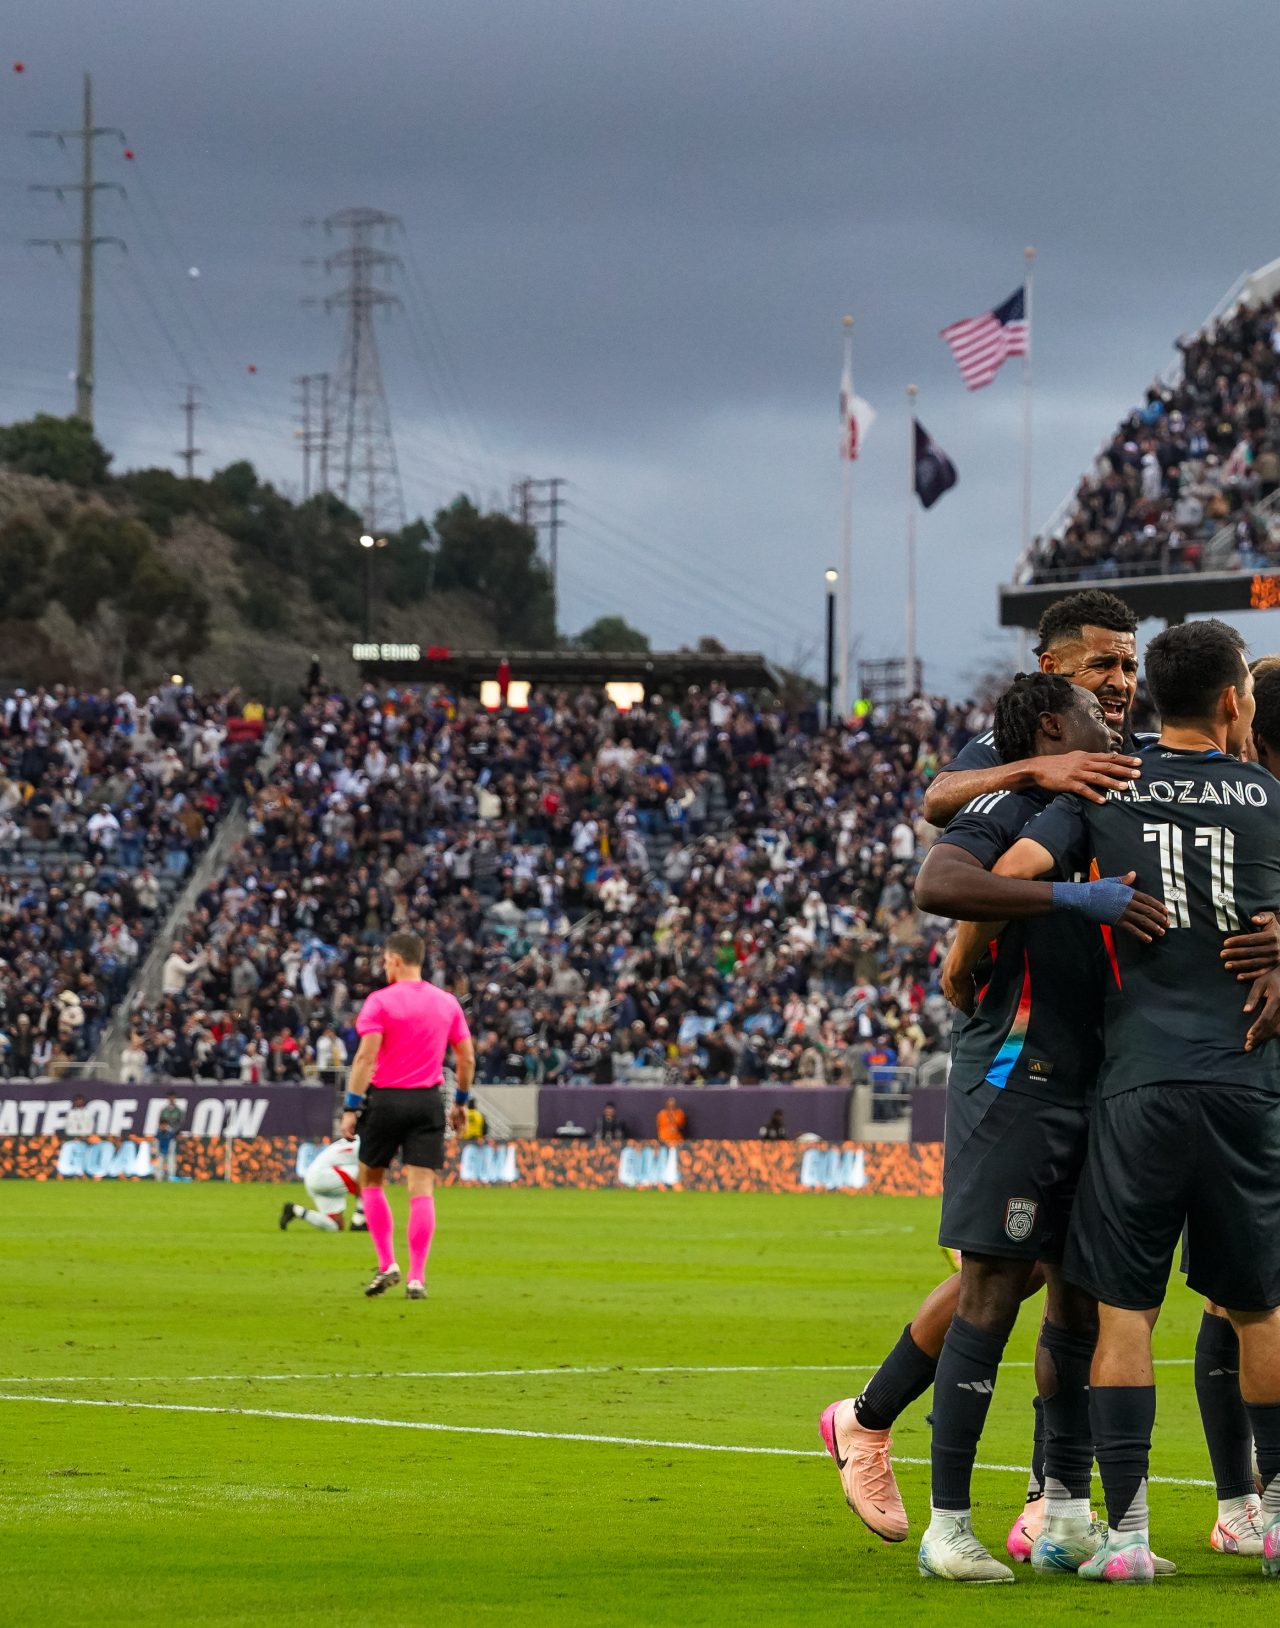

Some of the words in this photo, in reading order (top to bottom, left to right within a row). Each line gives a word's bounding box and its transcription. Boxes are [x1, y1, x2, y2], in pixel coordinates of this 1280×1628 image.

[1143, 823, 1240, 932] 11
[142, 1098, 270, 1138] FOW
[57, 1140, 155, 1177] GOAL
